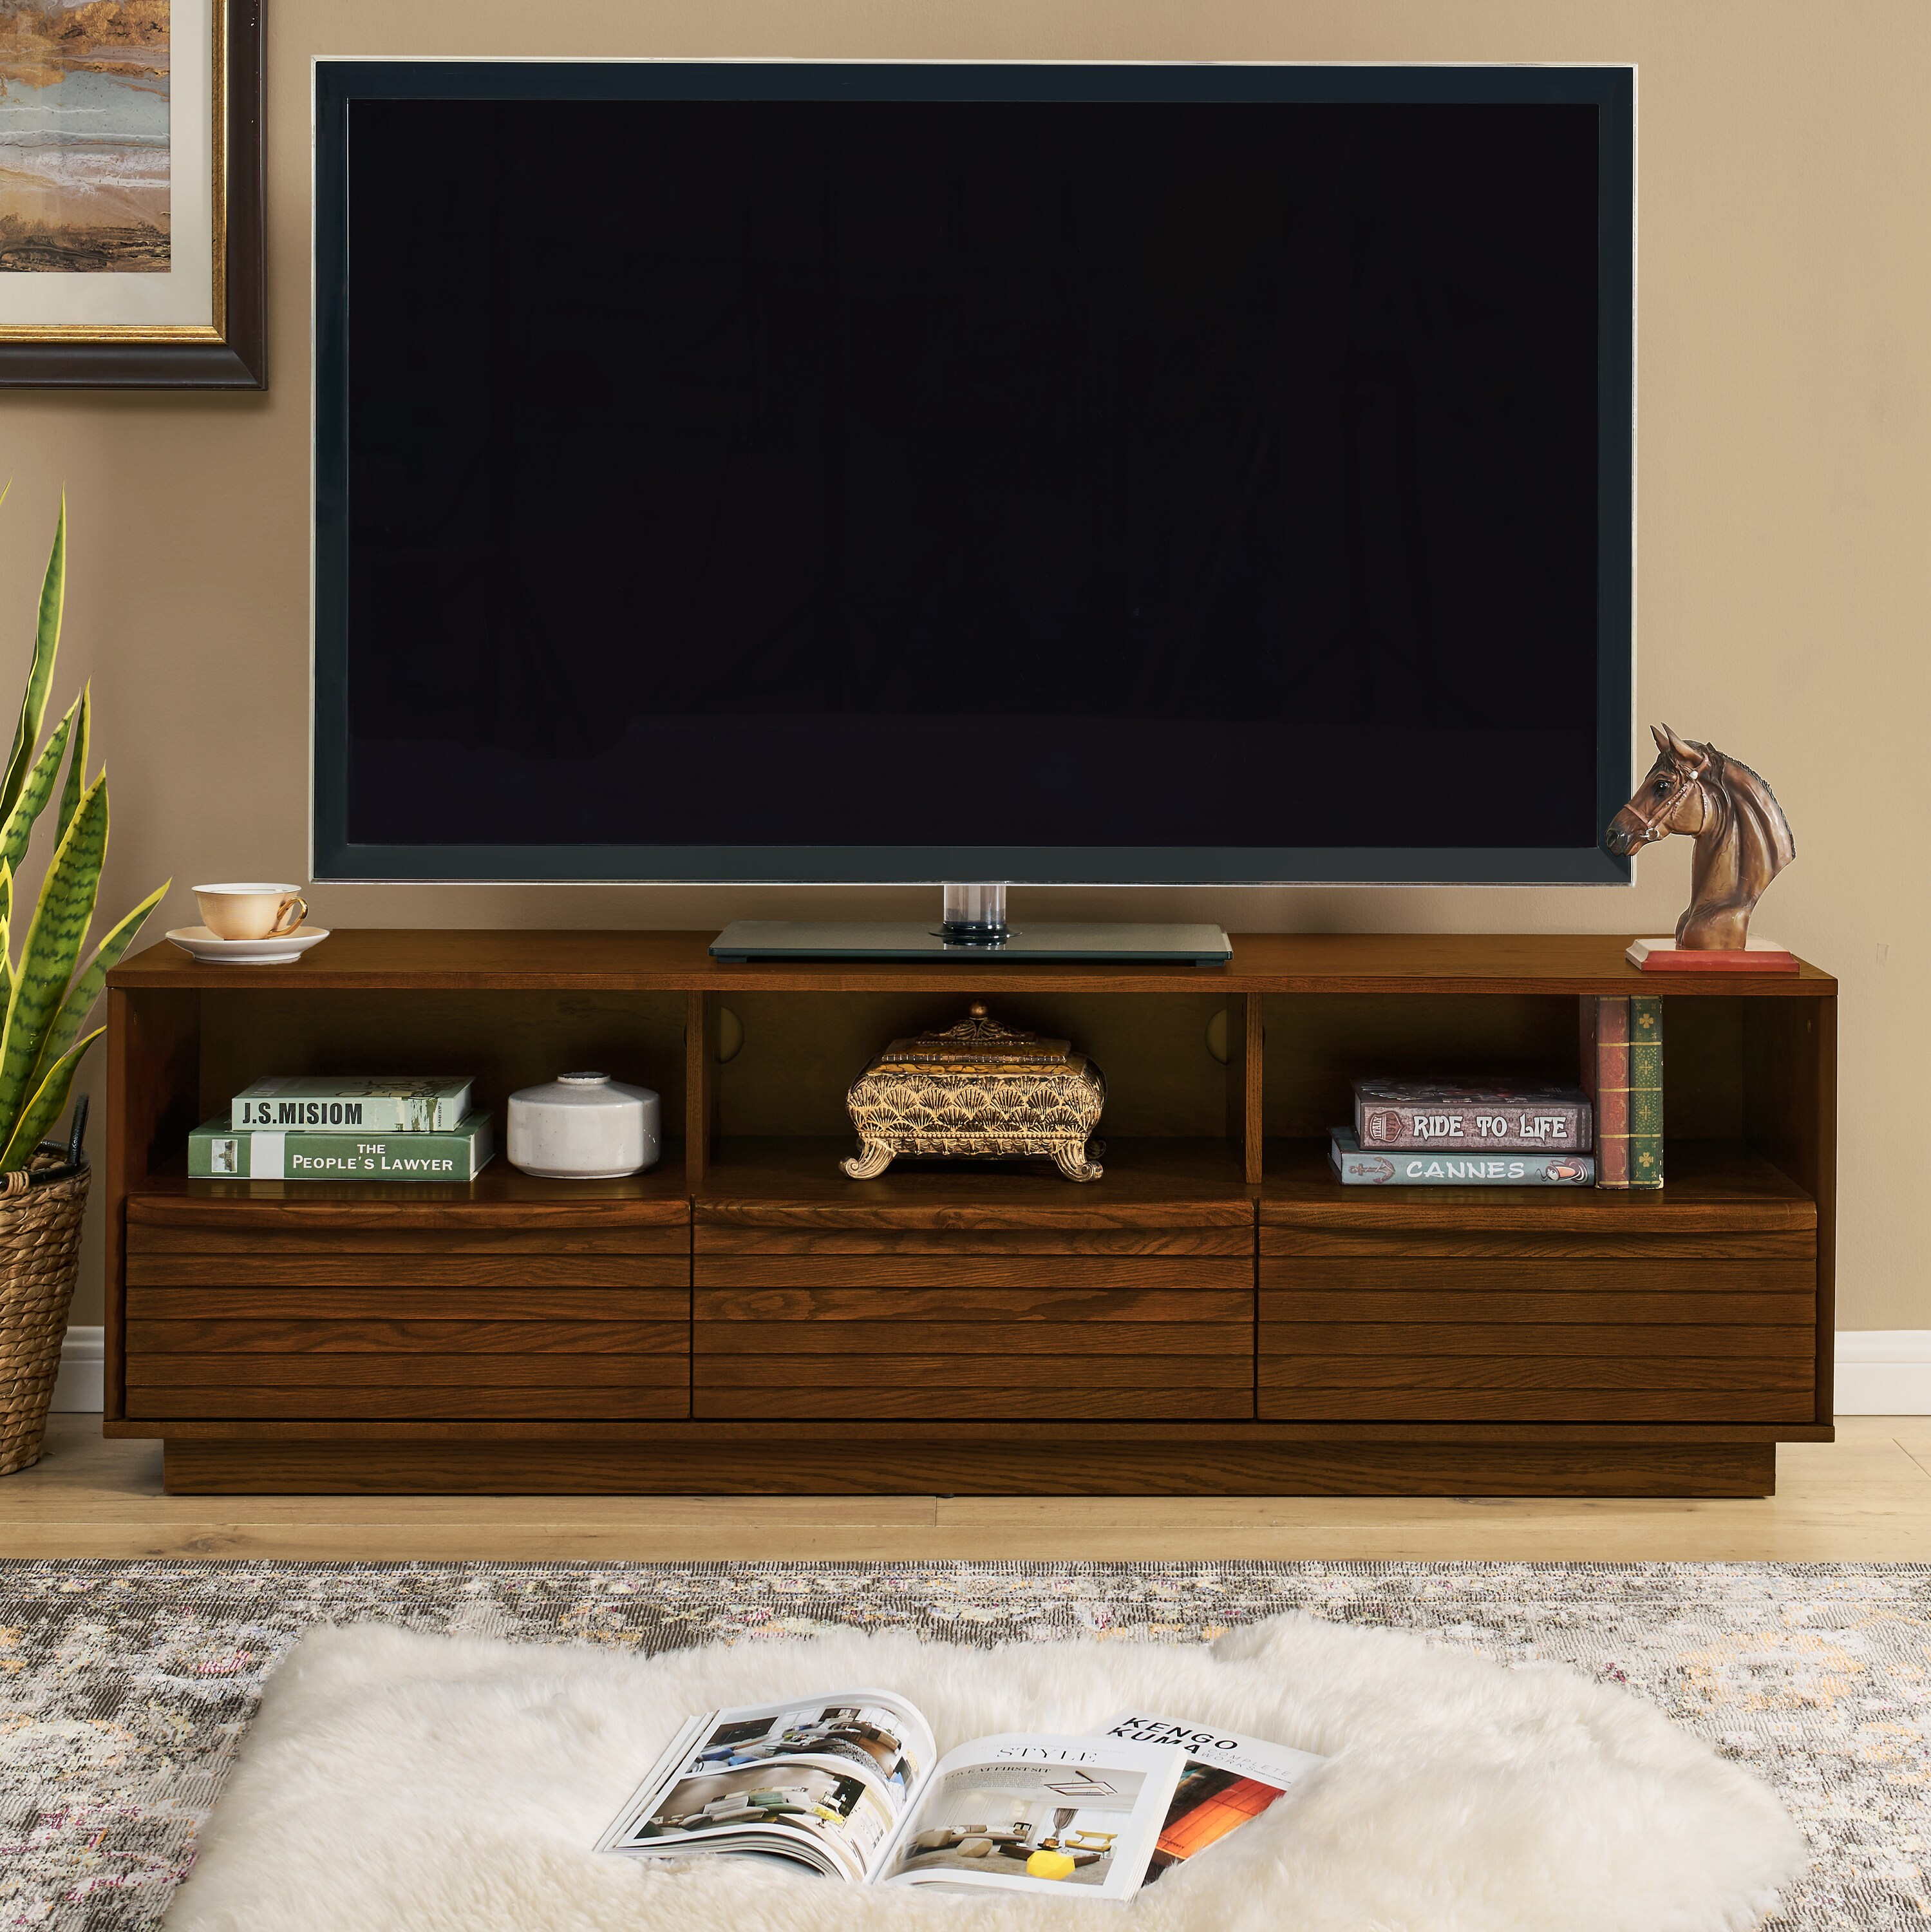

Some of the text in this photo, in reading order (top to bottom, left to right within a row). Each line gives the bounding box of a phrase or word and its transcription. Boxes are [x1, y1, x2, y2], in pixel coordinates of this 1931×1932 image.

[242, 1103, 363, 1124] J.S.MISIOM
[1372, 1117, 1382, 1137] ITALY
[1386, 1117, 1396, 1137] 1977
[1413, 1115, 1464, 1141] RIDE
[1476, 1115, 1507, 1137] TO
[1520, 1113, 1568, 1144] LIFE
[357, 1144, 386, 1154] THE
[293, 1155, 453, 1171] PEOPLE'S LAWYER
[1406, 1161, 1525, 1179] CANNES
[1106, 1727, 1201, 1754] KUMA
[1122, 1718, 1238, 1750] KENGO
[997, 1747, 1097, 1763] STYLE
[1201, 1752, 1255, 1771] WORKS
[1208, 1749, 1292, 1777] COMPLETE
